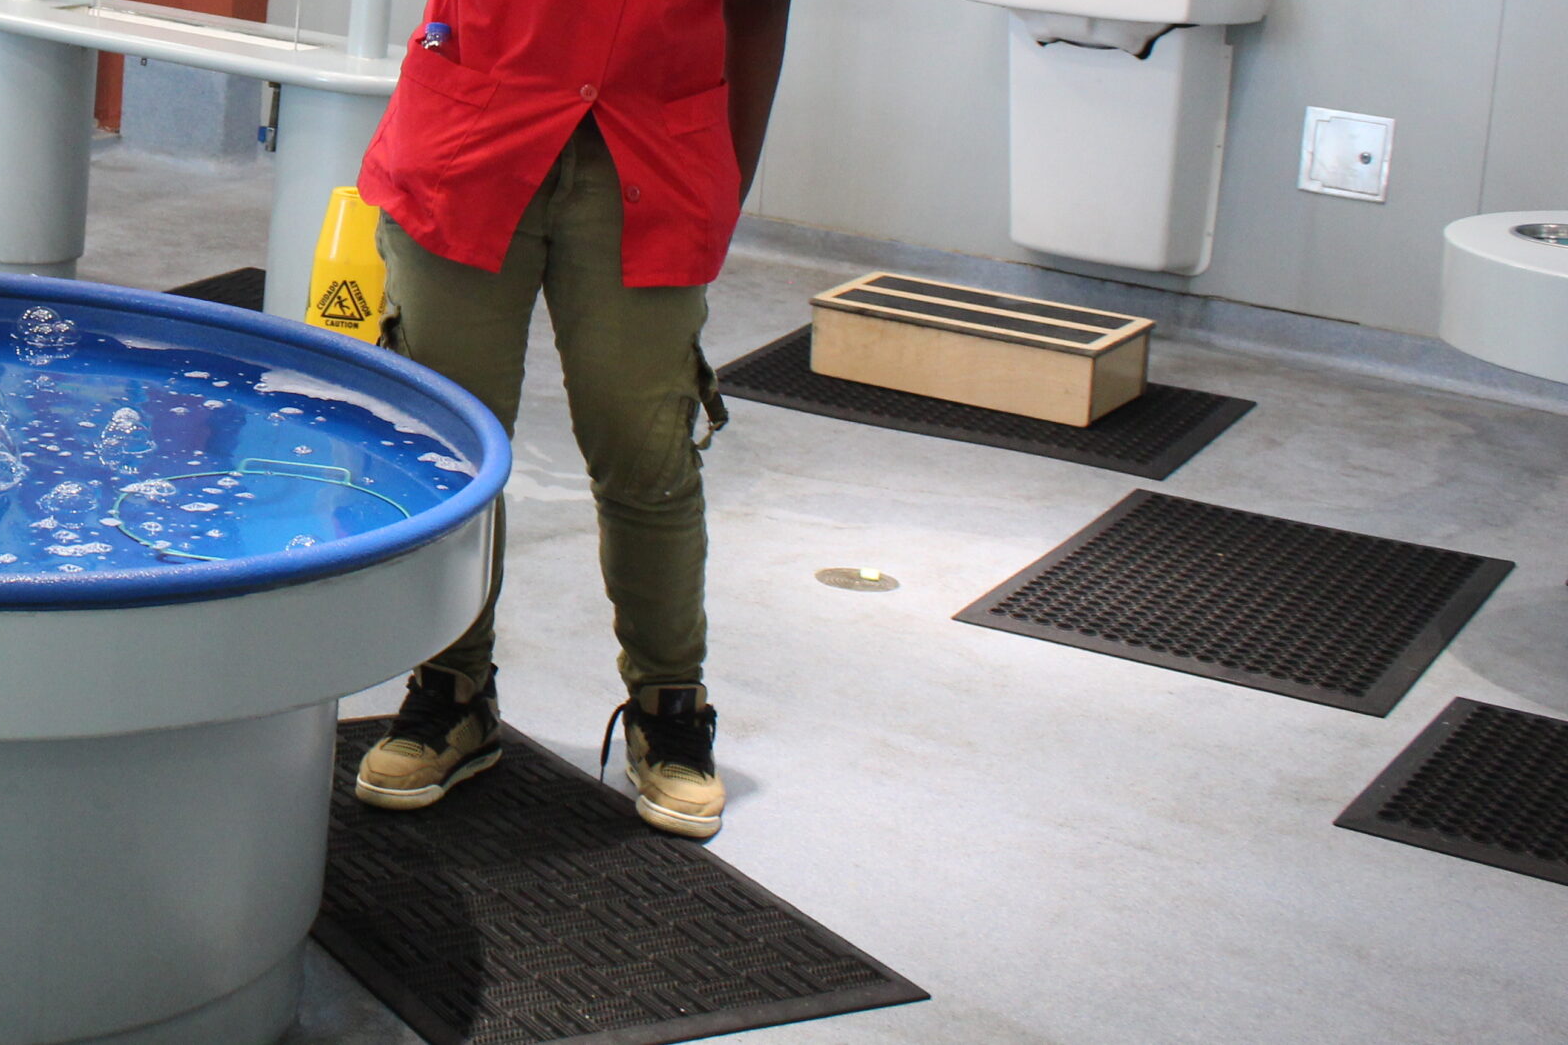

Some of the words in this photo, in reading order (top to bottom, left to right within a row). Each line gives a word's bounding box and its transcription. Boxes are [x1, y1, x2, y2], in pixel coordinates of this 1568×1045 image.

[316, 280, 339, 311] CUIDADO
[349, 280, 373, 318] ATTENTION
[325, 320, 359, 329] CAUTION
